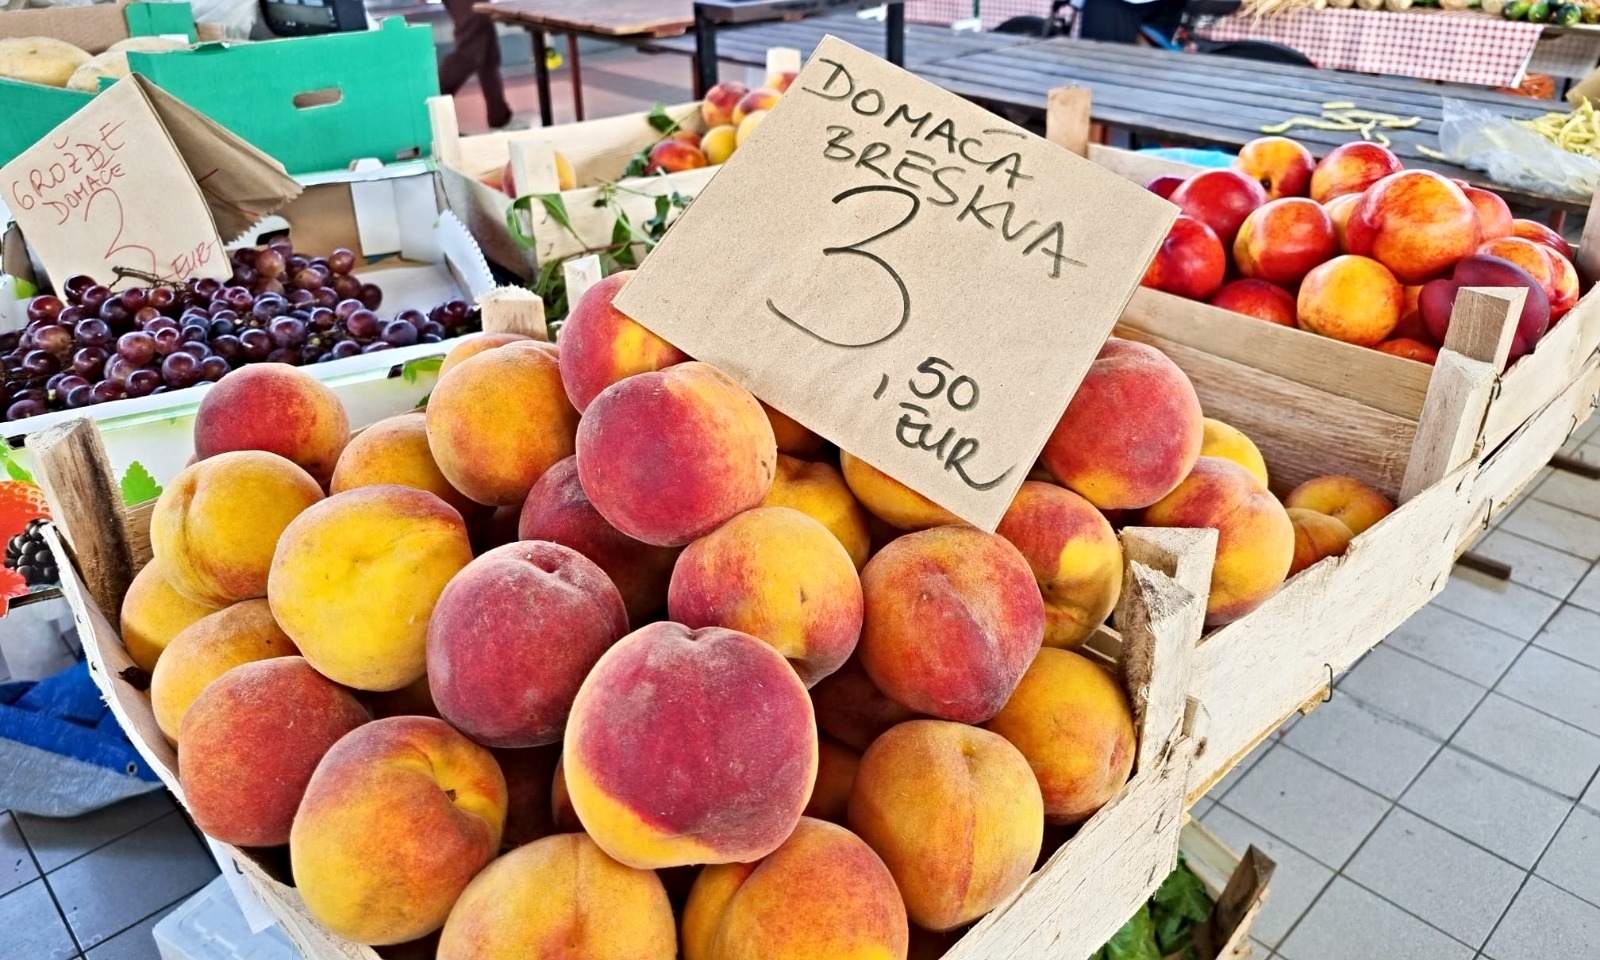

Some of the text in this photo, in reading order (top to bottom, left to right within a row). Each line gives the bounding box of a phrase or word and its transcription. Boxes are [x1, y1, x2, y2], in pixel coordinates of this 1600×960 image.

[84, 187, 158, 288] 2
[822, 124, 1089, 279] BRESKVA
[895, 401, 1018, 492] EUR
